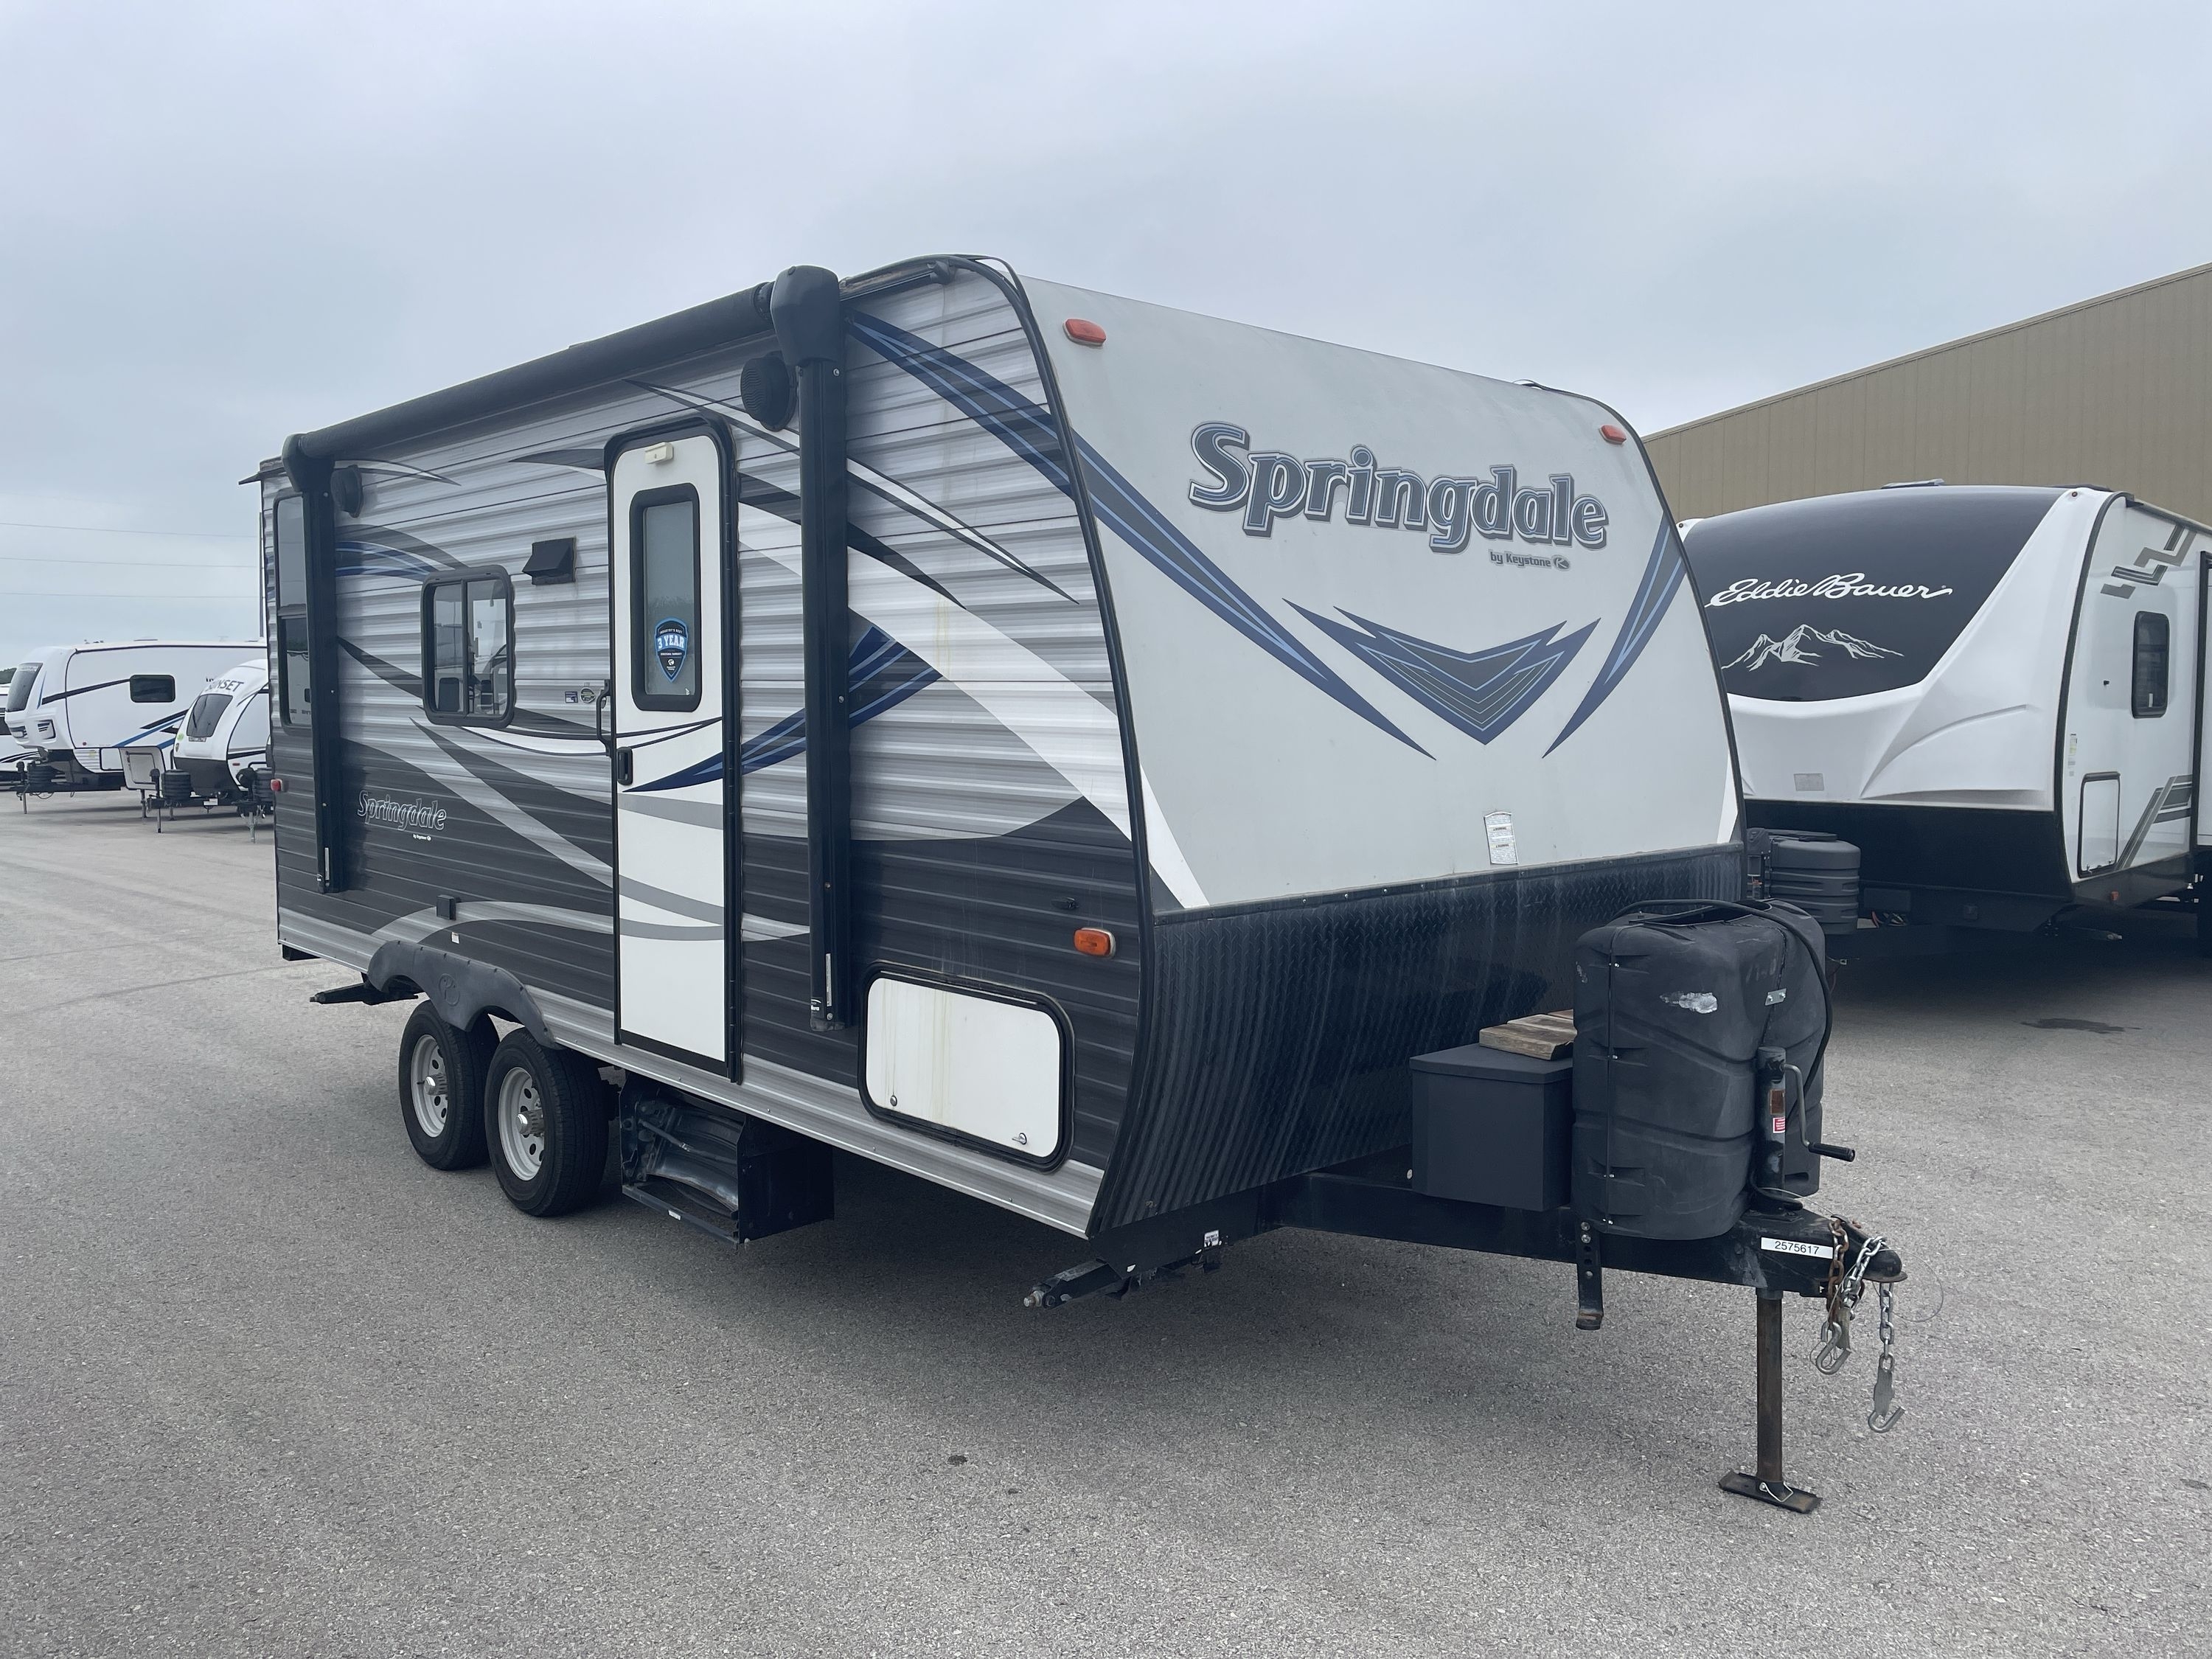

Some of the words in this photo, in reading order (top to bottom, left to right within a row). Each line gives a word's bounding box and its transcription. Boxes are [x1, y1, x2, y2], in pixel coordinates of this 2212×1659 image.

[1188, 421, 1609, 553] Springdale
[1490, 551, 1503, 565] by
[1506, 552, 1552, 568] Keystone
[1704, 578, 1809, 608] Eddie
[1810, 572, 1953, 599] Bauer
[657, 637, 663, 649] 3
[664, 634, 684, 649] YEAR
[358, 790, 447, 831] Springdale
[1775, 1240, 1820, 1255] 2575617
